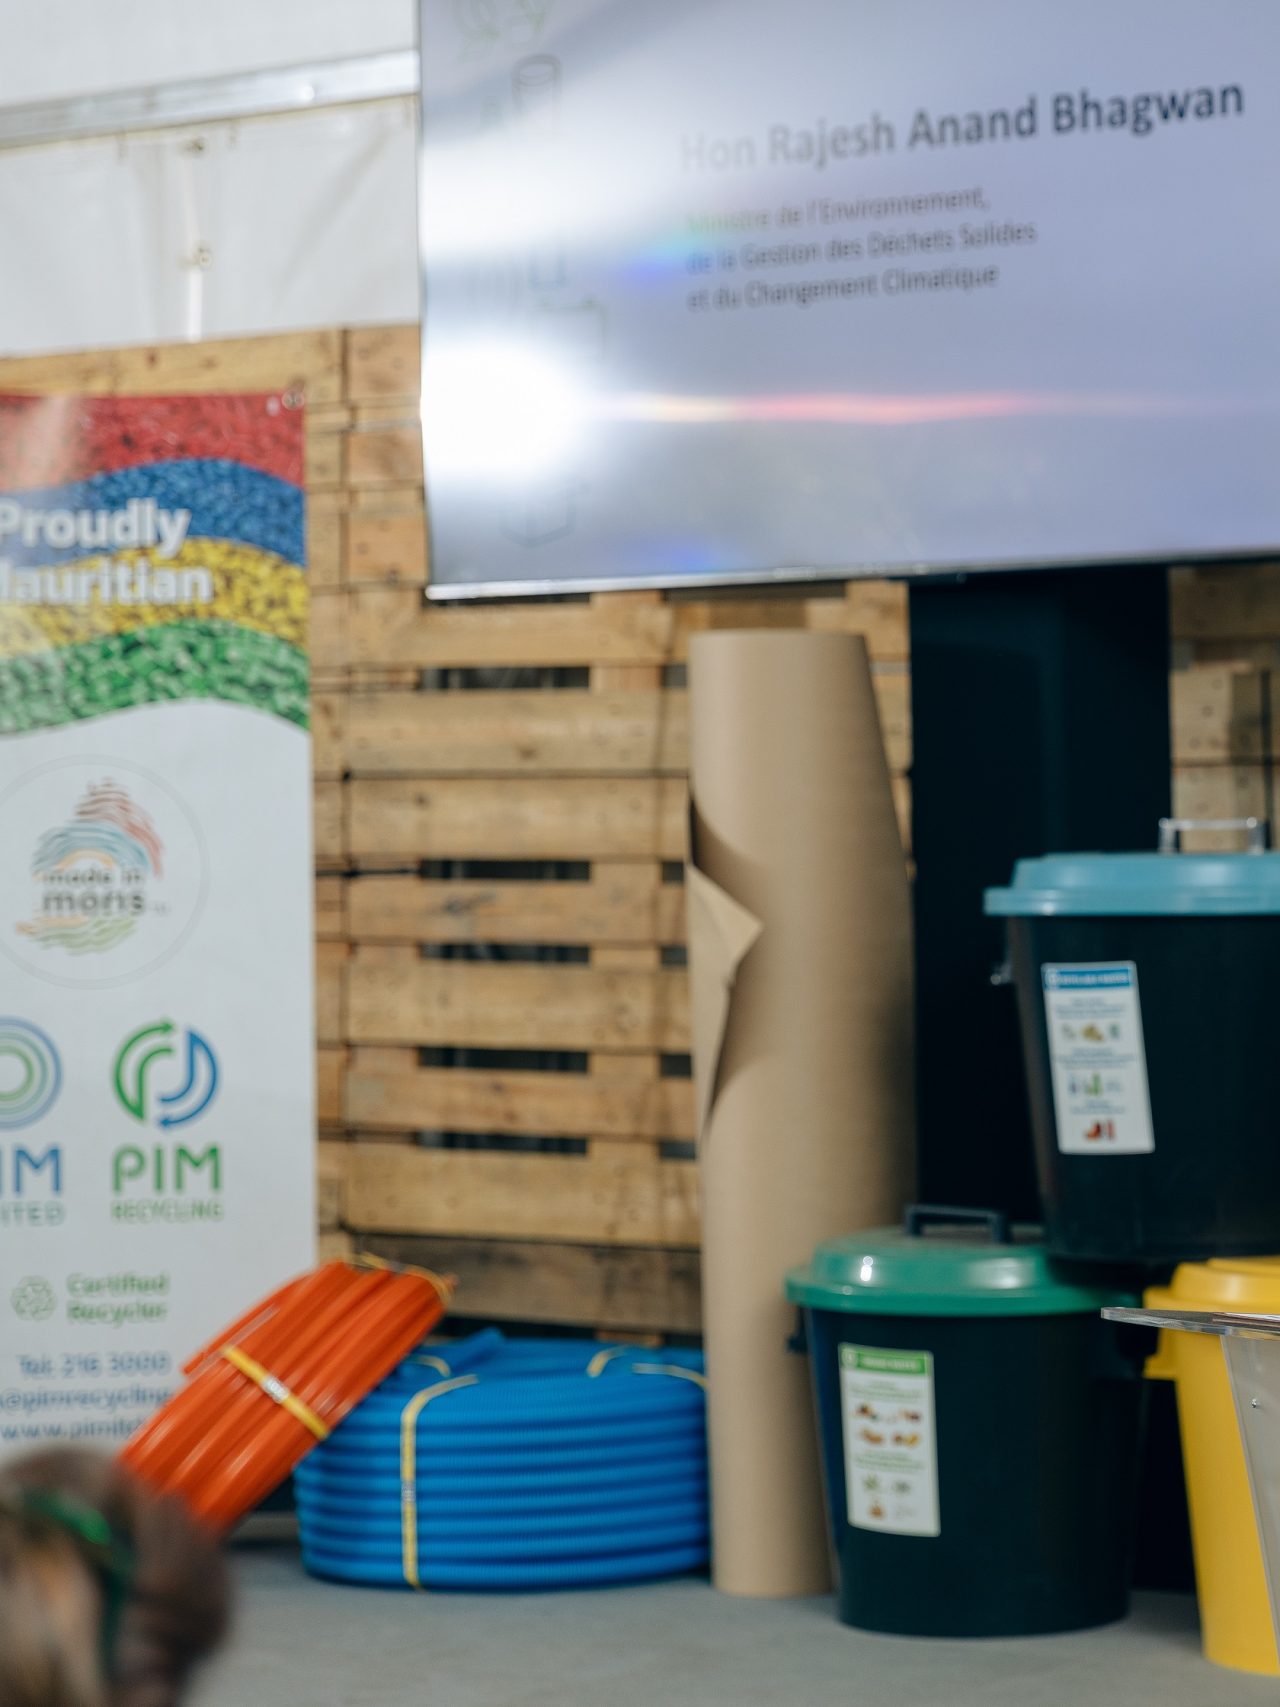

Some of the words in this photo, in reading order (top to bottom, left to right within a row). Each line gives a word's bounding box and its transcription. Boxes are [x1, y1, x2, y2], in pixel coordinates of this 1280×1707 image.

[681, 131, 756, 171] Hon
[767, 110, 895, 170] Rajesh
[907, 94, 1038, 149] Anand
[1052, 83, 1244, 135] Bhagwan
[776, 203, 803, 228] de
[685, 250, 714, 275] de
[716, 246, 738, 272] la
[740, 242, 823, 270] Gestion
[824, 238, 864, 263] des
[957, 220, 1038, 250] Solides
[685, 289, 711, 313] et
[712, 283, 741, 311] du
[743, 270, 878, 310] Changement
[880, 264, 1000, 295] Climatique
[0, 496, 192, 559] Proudly
[111, 1142, 222, 1195] PIM
[111, 1199, 224, 1224] RECYCLING
[66, 1271, 170, 1298] Certified
[66, 1300, 168, 1329] Recycler
